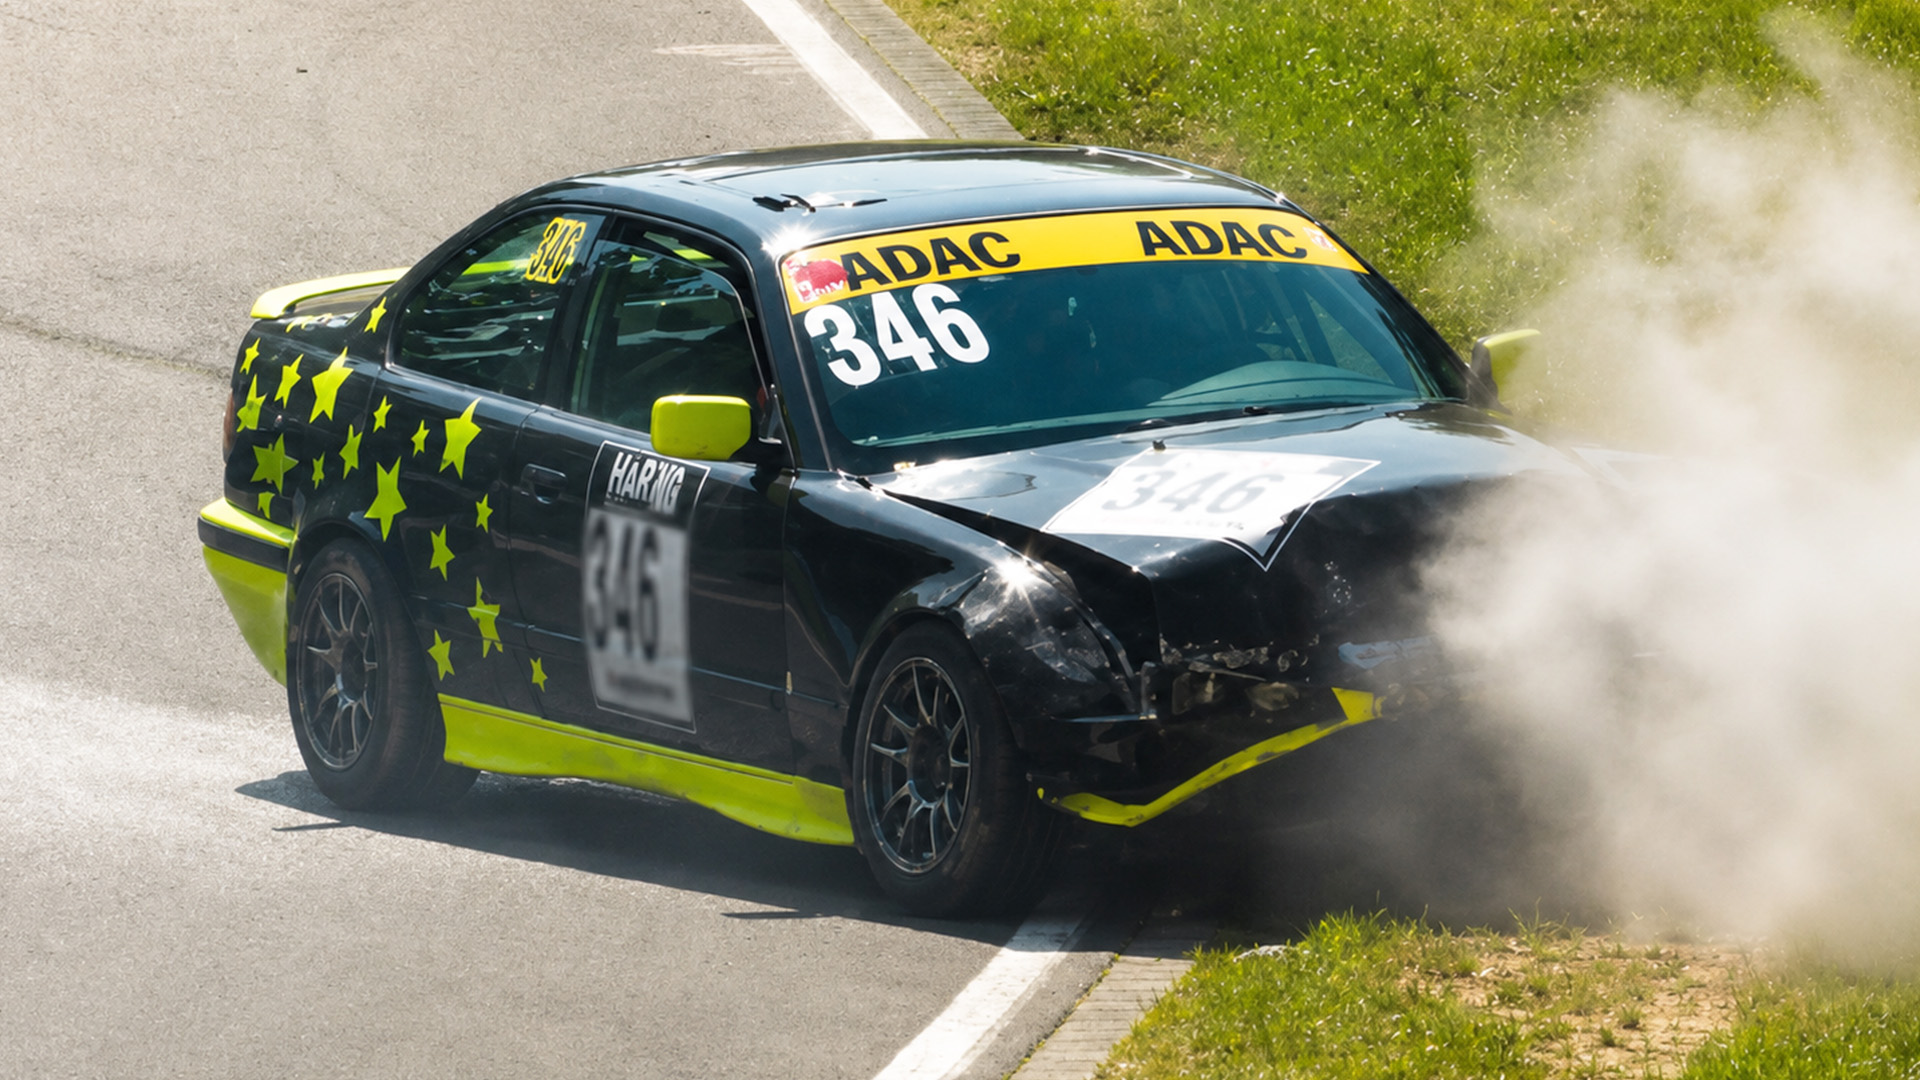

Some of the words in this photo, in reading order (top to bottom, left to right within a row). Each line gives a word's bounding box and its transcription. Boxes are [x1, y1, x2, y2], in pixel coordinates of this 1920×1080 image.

[526, 217, 586, 284] 346
[840, 231, 1021, 291] ADAC
[1135, 220, 1308, 259] ADAC
[804, 283, 990, 386] 346
[1101, 470, 1285, 514] 346
